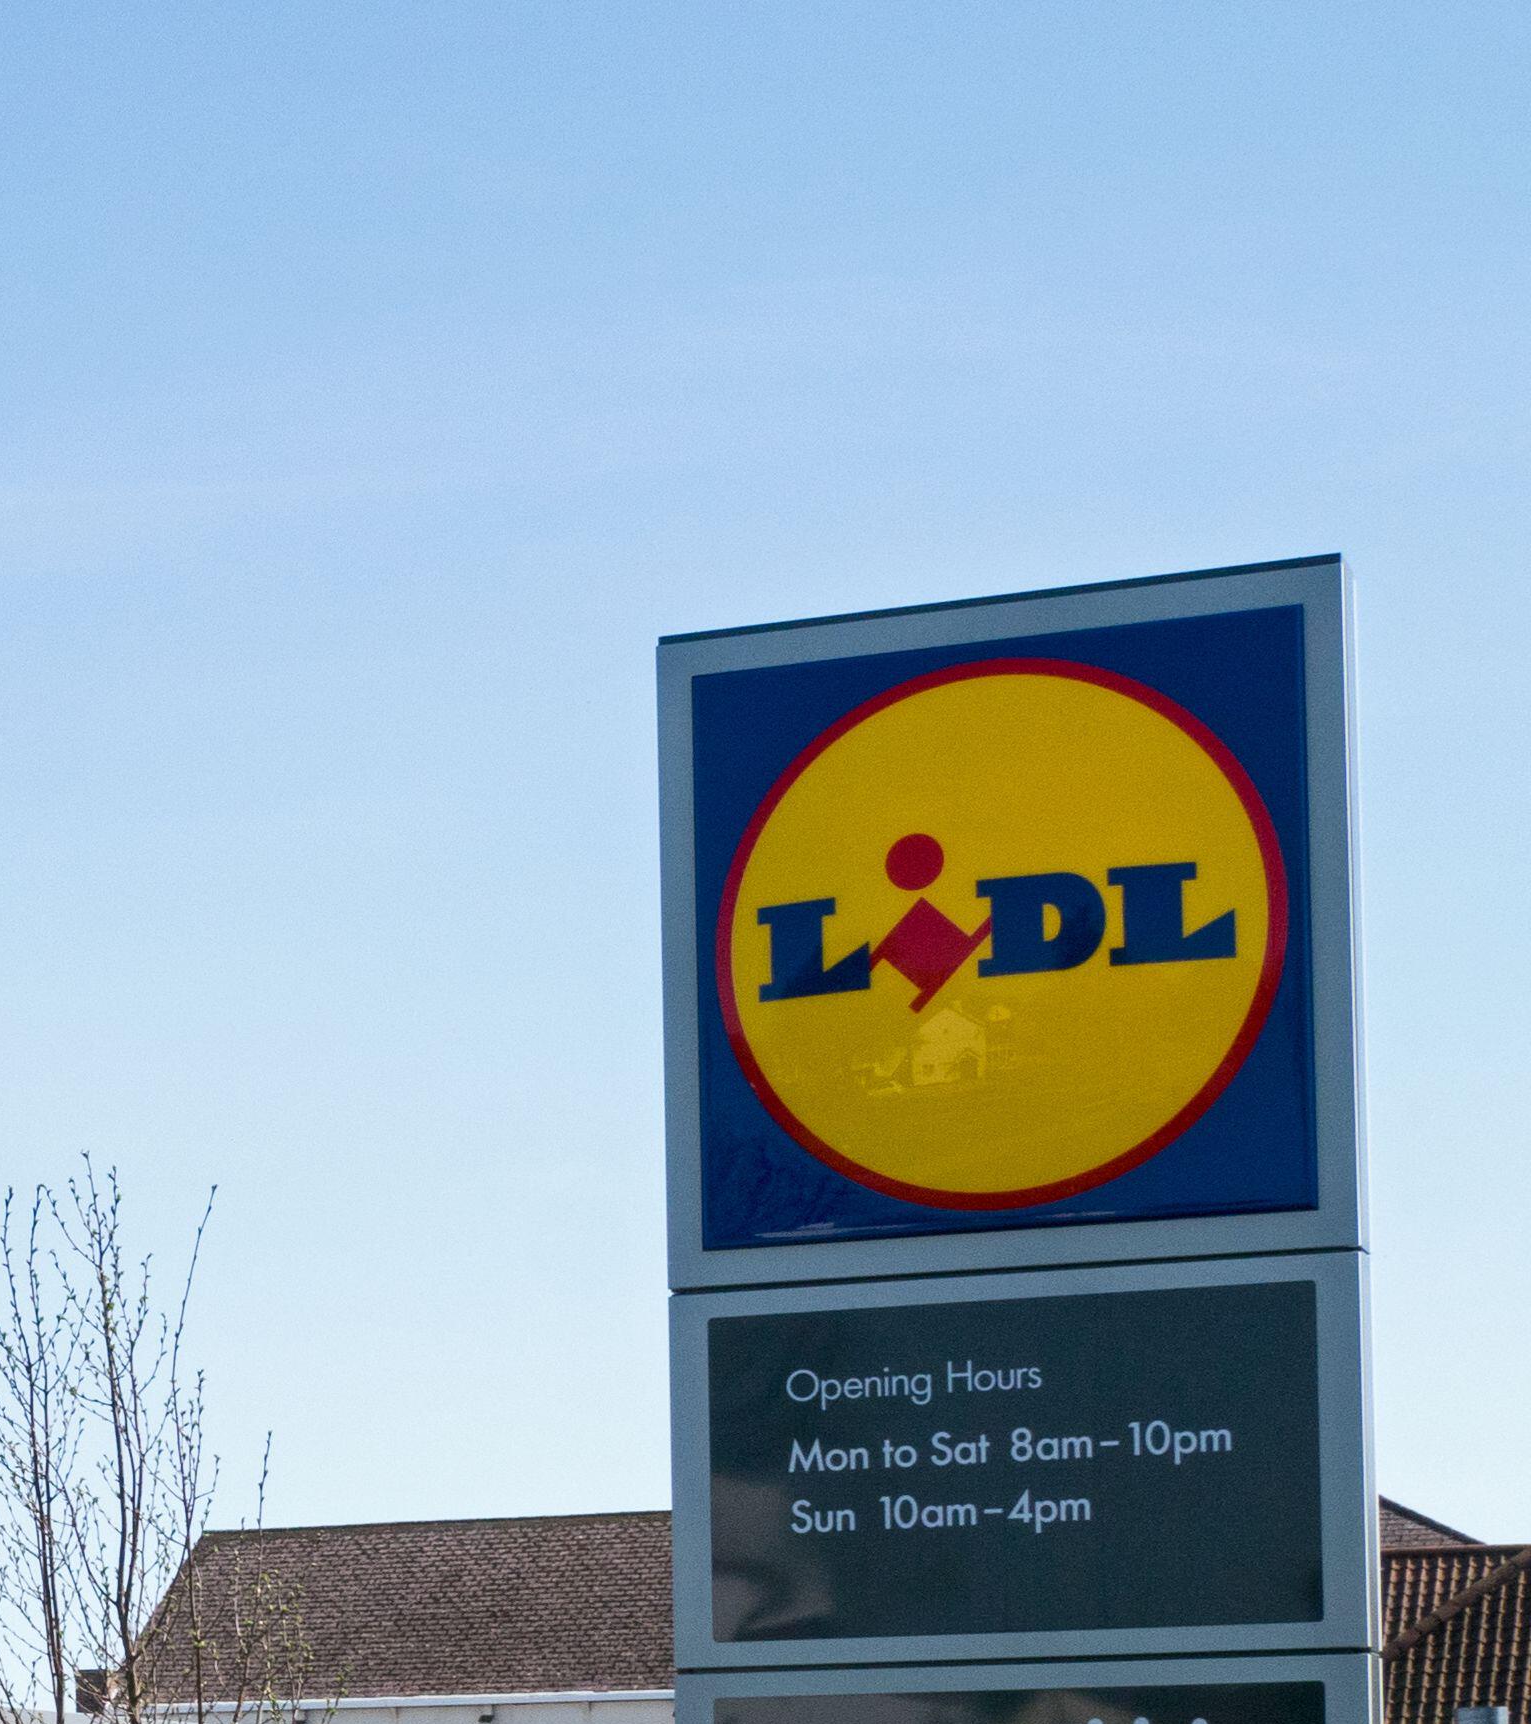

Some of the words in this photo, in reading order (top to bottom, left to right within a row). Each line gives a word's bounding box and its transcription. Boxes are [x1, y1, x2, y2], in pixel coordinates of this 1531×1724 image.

[785, 1366, 933, 1411] Opening
[947, 1360, 1042, 1393] Hours
[788, 1440, 870, 1474] Mon
[882, 1438, 918, 1469] to
[931, 1430, 990, 1467] Sat
[790, 1497, 857, 1535] Sun
